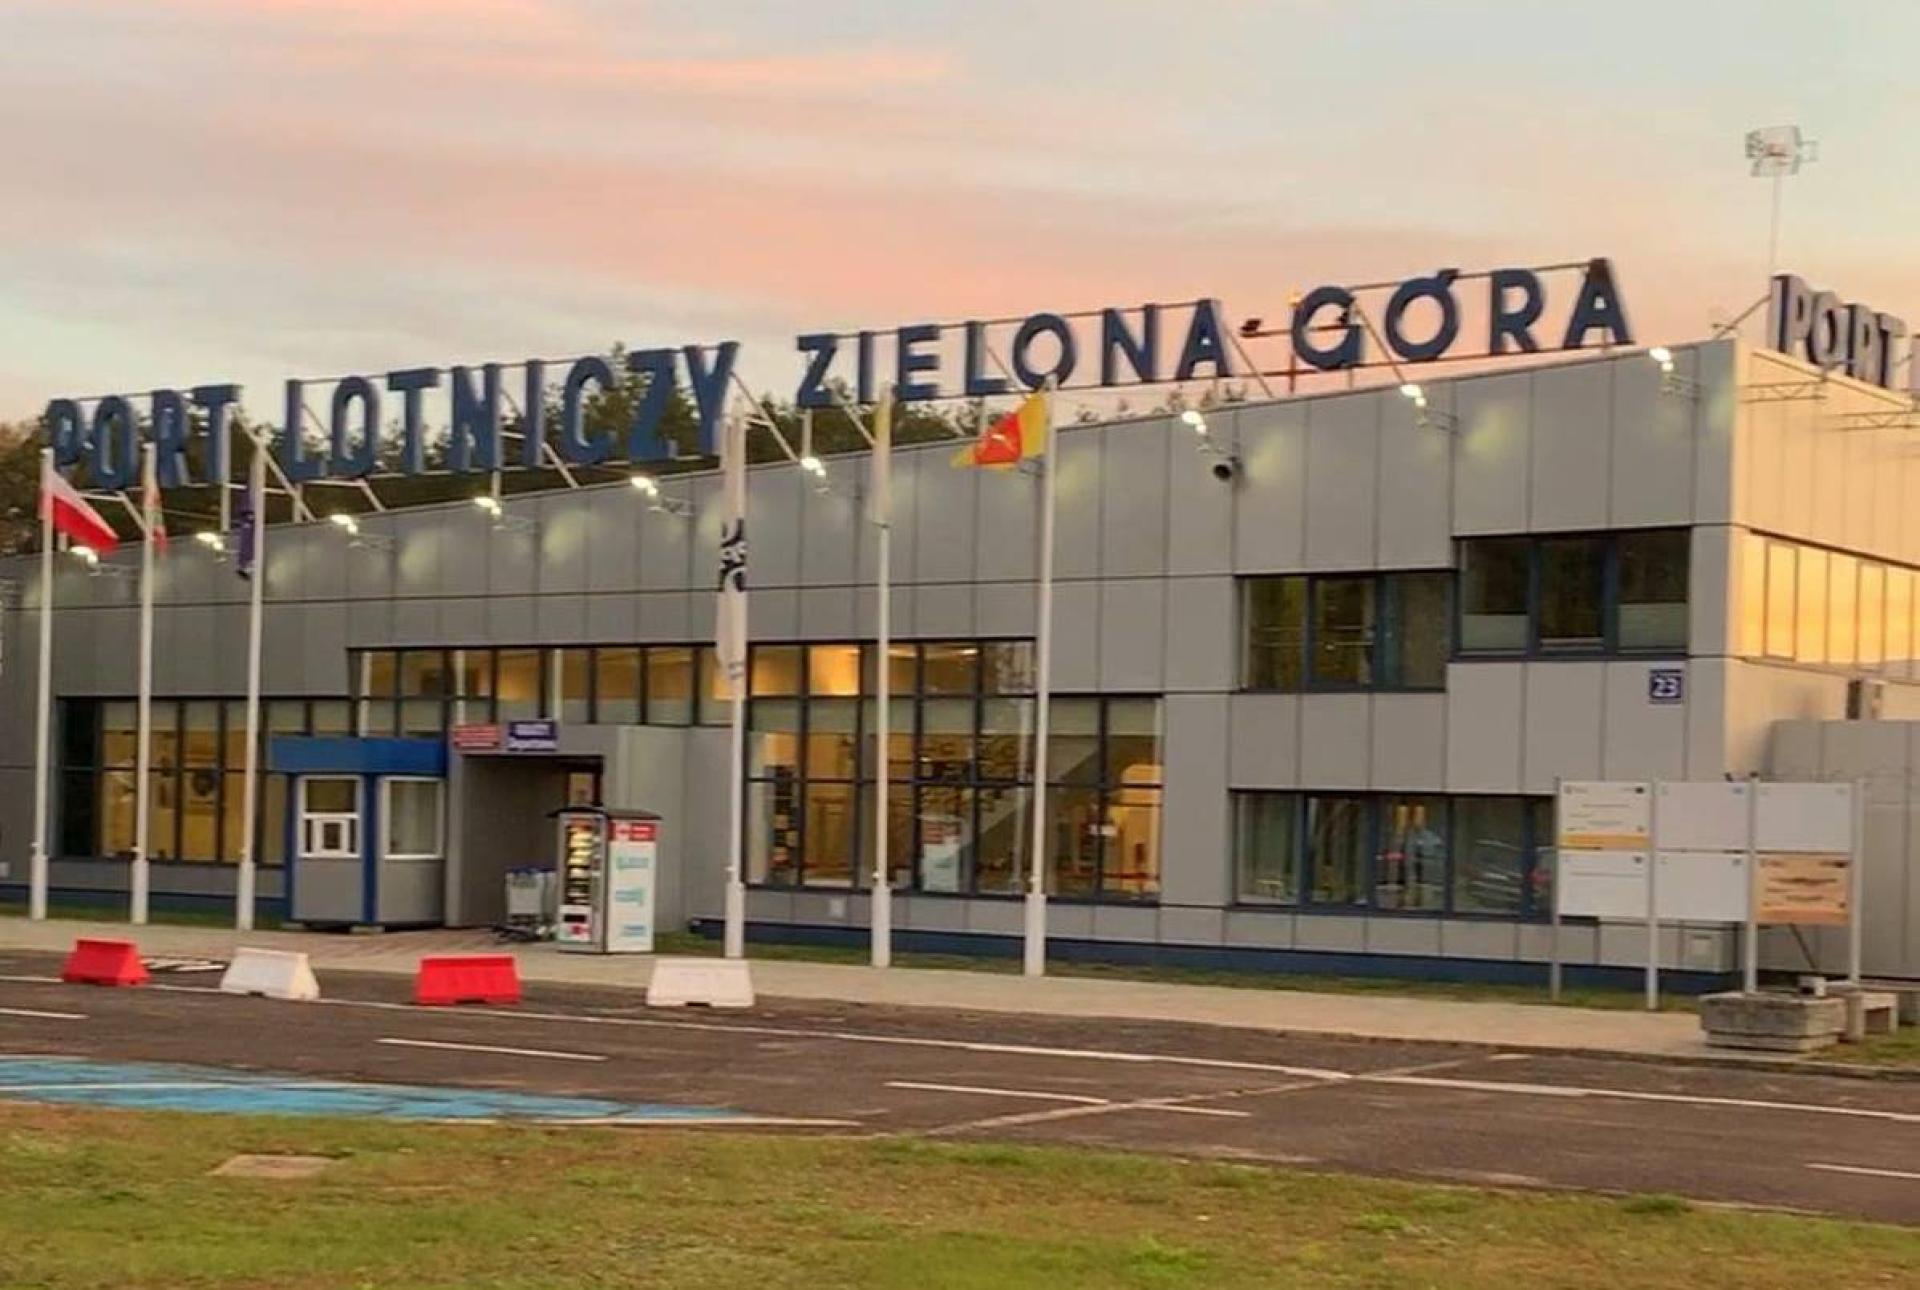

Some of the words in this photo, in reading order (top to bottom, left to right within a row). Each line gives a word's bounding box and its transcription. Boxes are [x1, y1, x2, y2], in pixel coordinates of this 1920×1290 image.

[46, 384, 241, 490] PORT
[285, 341, 740, 480] LOTNICZY
[796, 298, 1232, 405] ZIELONA
[1291, 257, 1634, 369] GÓRA
[1769, 274, 1905, 388] PORT
[1653, 677, 1677, 697] 23
